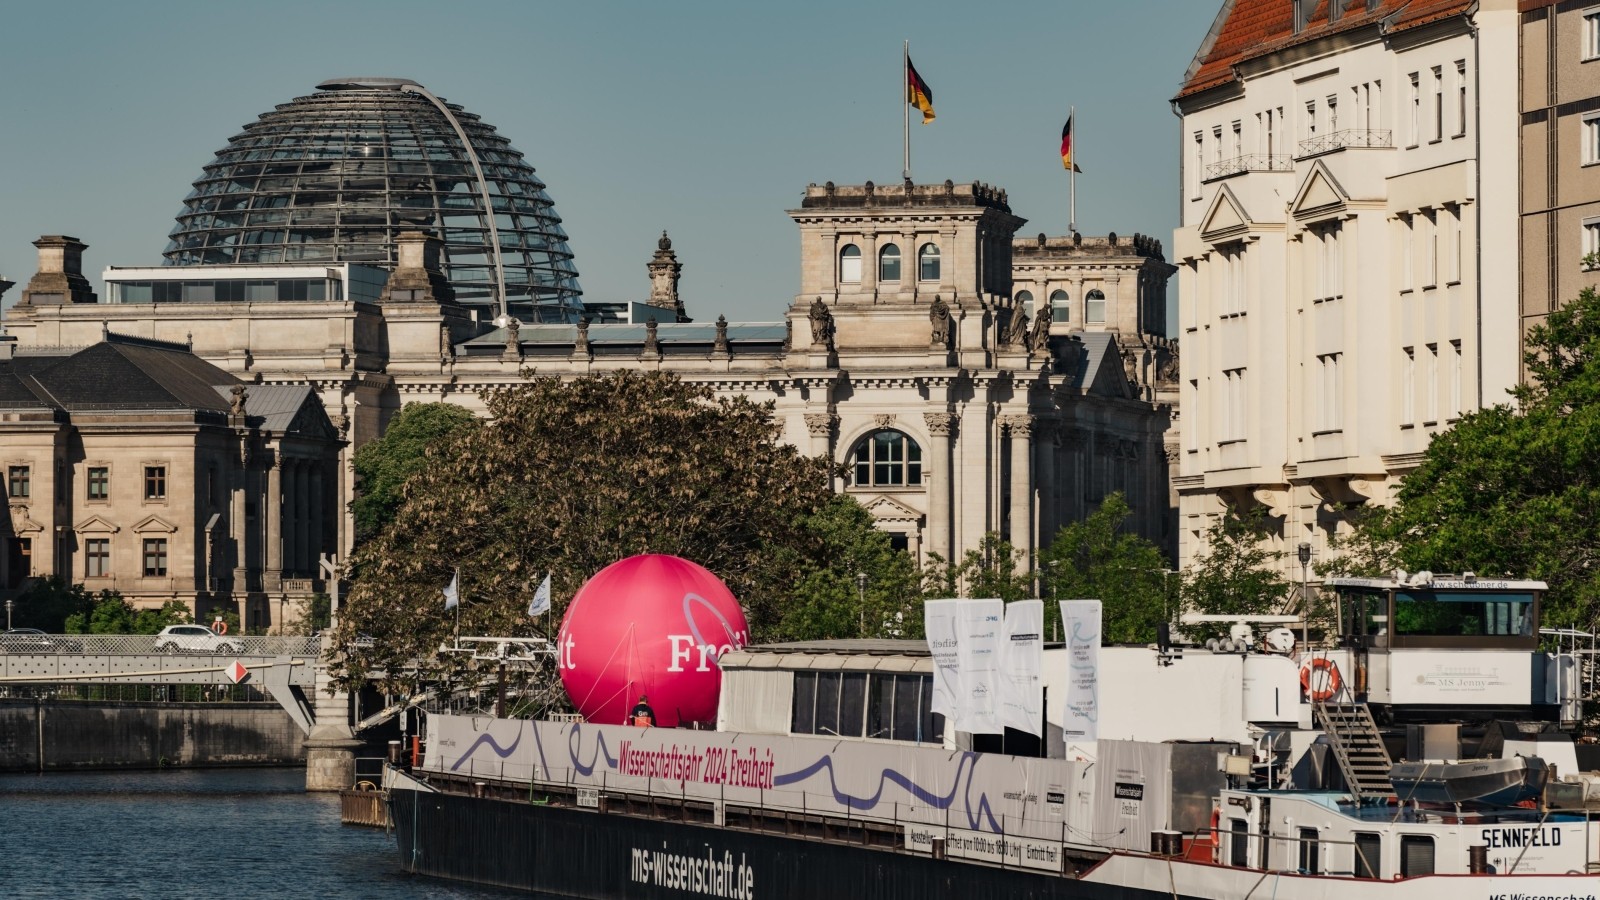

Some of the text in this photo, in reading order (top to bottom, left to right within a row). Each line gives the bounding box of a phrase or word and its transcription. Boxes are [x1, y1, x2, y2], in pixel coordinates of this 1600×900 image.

[1438, 679, 1487, 688] MS Jenny
[619, 740, 774, 790] Wissenschaftsjahr 2024 Freiheit
[1482, 827, 1561, 848] SENNFELD
[631, 840, 754, 900] ms-wissenschaft.de
